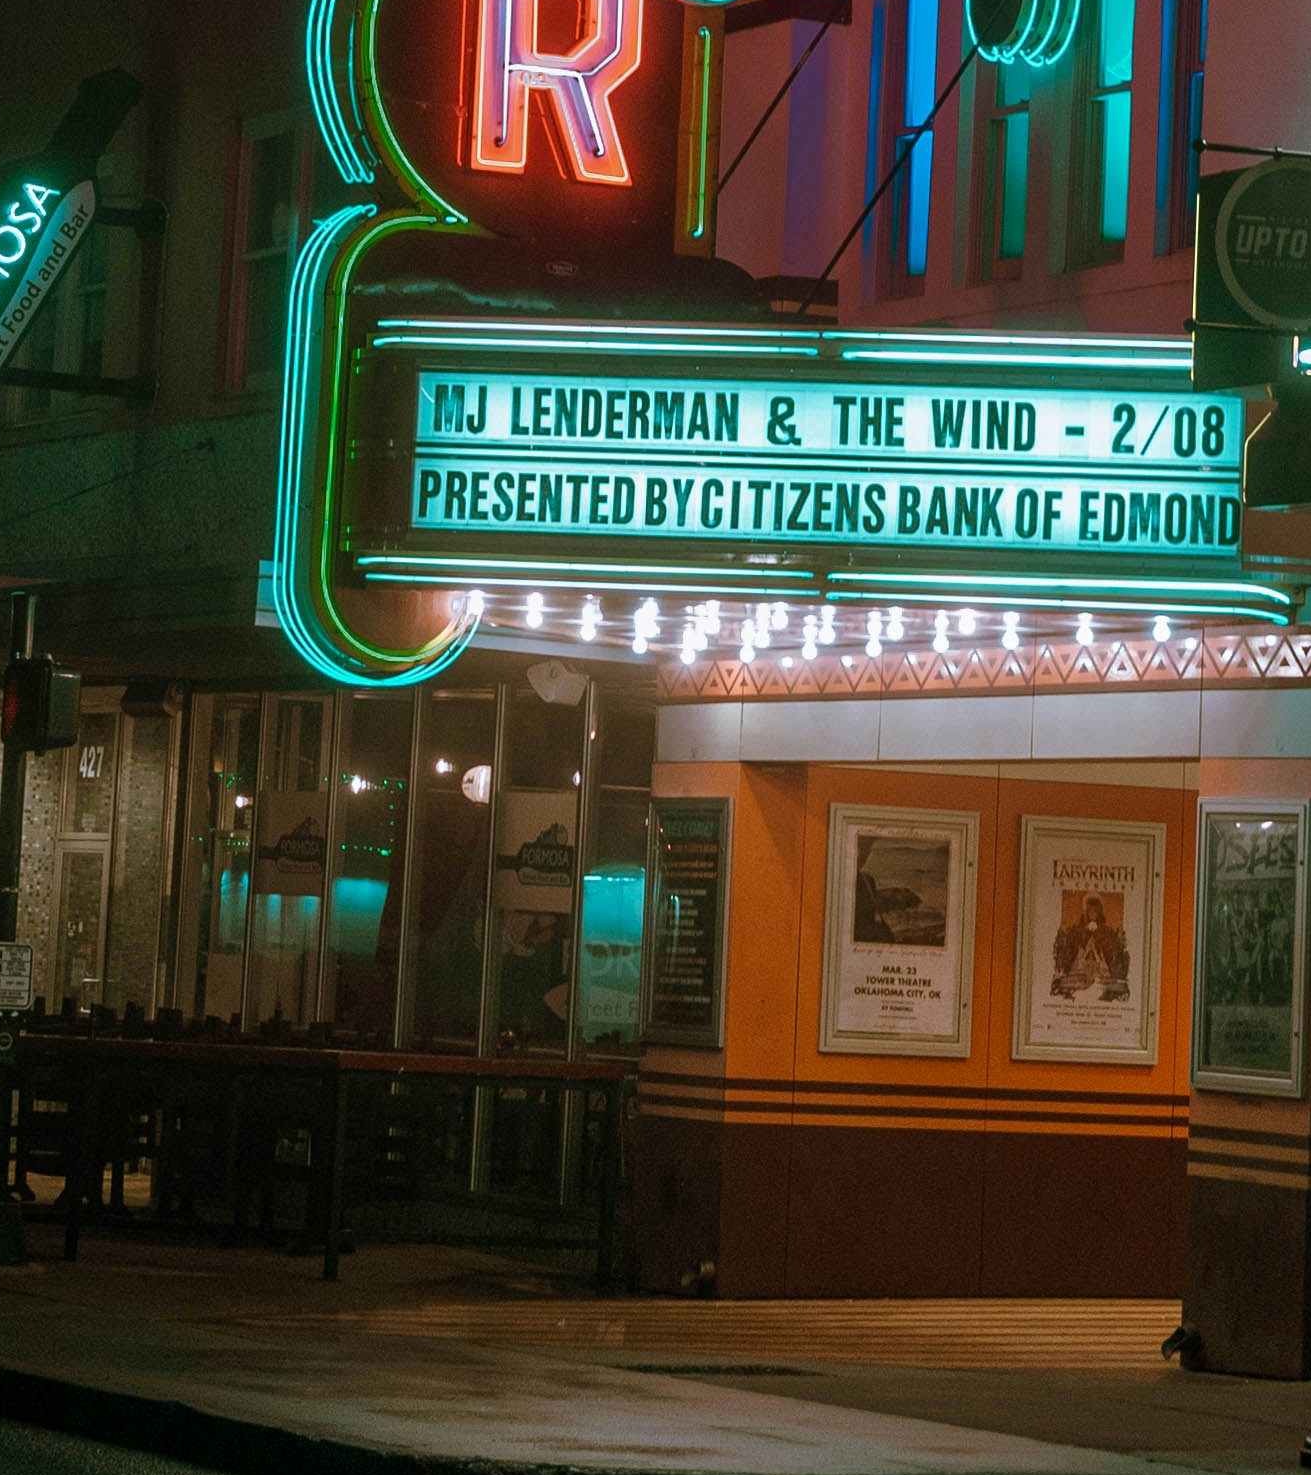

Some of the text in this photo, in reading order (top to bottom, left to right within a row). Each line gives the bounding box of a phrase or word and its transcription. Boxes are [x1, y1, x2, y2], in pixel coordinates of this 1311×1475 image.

[1, 279, 42, 334] Food
[37, 239, 67, 283] and
[60, 204, 90, 240] Bar
[433, 384, 487, 434] MJ
[511, 386, 739, 442] LENDERMAN
[767, 395, 801, 446] &
[833, 396, 905, 447] THE
[931, 399, 1036, 452] WIND
[1112, 402, 1226, 458] 2/08
[418, 469, 1241, 547] PRESENTED BY CITIZENS BANK OF EDMOND
[79, 745, 105, 779] 427
[1053, 859, 1135, 882] LABYRINTH
[866, 976, 932, 988] TOWER THEATRE
[881, 965, 918, 975] MAR. 23
[853, 986, 905, 997] OKLAHOMA
[928, 990, 942, 1000] OK
